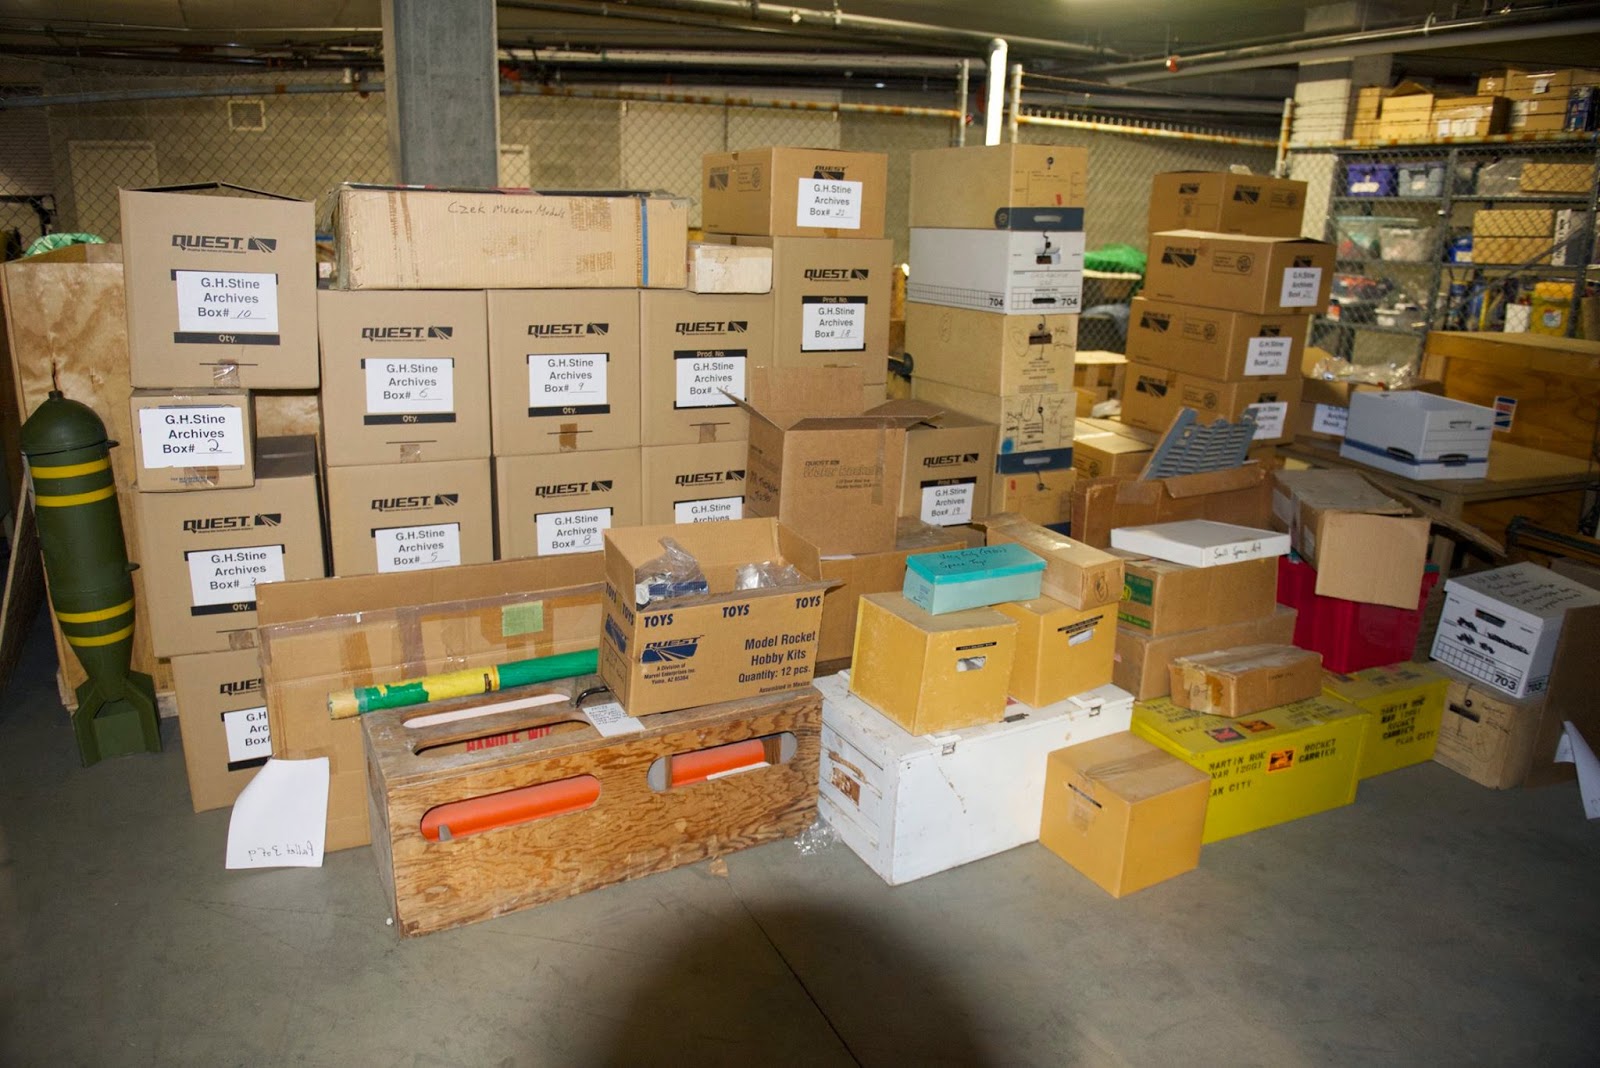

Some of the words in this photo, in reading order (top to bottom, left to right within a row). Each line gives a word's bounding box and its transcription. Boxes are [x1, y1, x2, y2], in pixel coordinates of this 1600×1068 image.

[814, 184, 852, 194] G.H.Stine
[814, 196, 850, 206] Archives
[493, 203, 533, 215] Museum
[809, 207, 830, 216] Box#
[171, 234, 244, 251] QUEST
[804, 269, 848, 281] QUEST
[200, 277, 260, 289] G.H.Stine
[203, 292, 259, 304] Archives
[989, 297, 1004, 307] 704
[1062, 297, 1078, 306] 704
[197, 306, 229, 318] Box#
[236, 309, 252, 318] 10
[818, 307, 856, 316] G.H.Stine
[675, 321, 726, 336] QUEST
[819, 318, 854, 327] Archives
[361, 326, 425, 342] QUEST
[527, 323, 584, 338] QUEST
[814, 329, 835, 338] Box#
[218, 334, 238, 344] Qty.
[386, 363, 438, 374] G.H.Stine
[547, 358, 594, 368] G.H.Stine
[692, 362, 734, 372] G.H.Stine
[388, 377, 437, 387] Archives
[549, 371, 593, 381] Archives
[694, 374, 733, 383] Archives
[383, 390, 411, 400] Box#
[419, 387, 431, 399] 6
[544, 383, 569, 393] Box#
[689, 386, 712, 395] Box#
[562, 407, 578, 415] Qty.
[165, 414, 226, 425] G.H.Stine
[402, 415, 419, 423] Qty.
[168, 429, 225, 439] Archives
[162, 444, 195, 454] Box#
[207, 439, 223, 453] 2
[922, 454, 962, 468] QUEST
[674, 471, 724, 487] QUEST
[535, 481, 589, 499] QUEST
[934, 488, 967, 497] G.H.Stine
[371, 495, 431, 512] QUEST
[935, 498, 965, 507] Archives
[691, 503, 731, 515] G.H.Stine
[931, 509, 949, 517] Box#
[183, 515, 251, 534] QUEST
[554, 514, 599, 526] G.H.Stine
[693, 514, 730, 524] Archives
[395, 529, 446, 542] G.H.Stine
[556, 526, 598, 537] Archives
[398, 541, 445, 554] Archives
[551, 539, 576, 550] Box#
[583, 534, 592, 546] 8
[210, 551, 267, 564] G.H.Stine
[393, 556, 420, 566] Box#
[431, 551, 439, 563] 5
[214, 565, 267, 577] Archives
[209, 579, 240, 591] Box#
[232, 603, 251, 611] Qty.
[795, 595, 822, 609] TOYS
[622, 602, 634, 626] TOYS
[722, 604, 750, 618] TOYS
[644, 612, 674, 628] TOYS
[645, 635, 705, 649] QUEST
[744, 635, 778, 650] Model
[780, 630, 816, 645] Rocket
[751, 651, 784, 667] Hobby
[786, 649, 807, 661] Kits
[661, 664, 681, 672] Division
[738, 669, 778, 684] Quantity:
[781, 667, 792, 677] 12
[793, 665, 811, 676] pcs.
[219, 678, 262, 696] QUE
[1494, 674, 1517, 691] 703
[1304, 738, 1336, 752] ROCKET
[1298, 747, 1336, 763] CARRIER
[1208, 757, 1245, 772] MARTIN
[1249, 751, 1266, 761] ROE
[1211, 769, 1229, 780] NAR
[1210, 786, 1225, 797] AK
[1229, 779, 1252, 793] CITY
